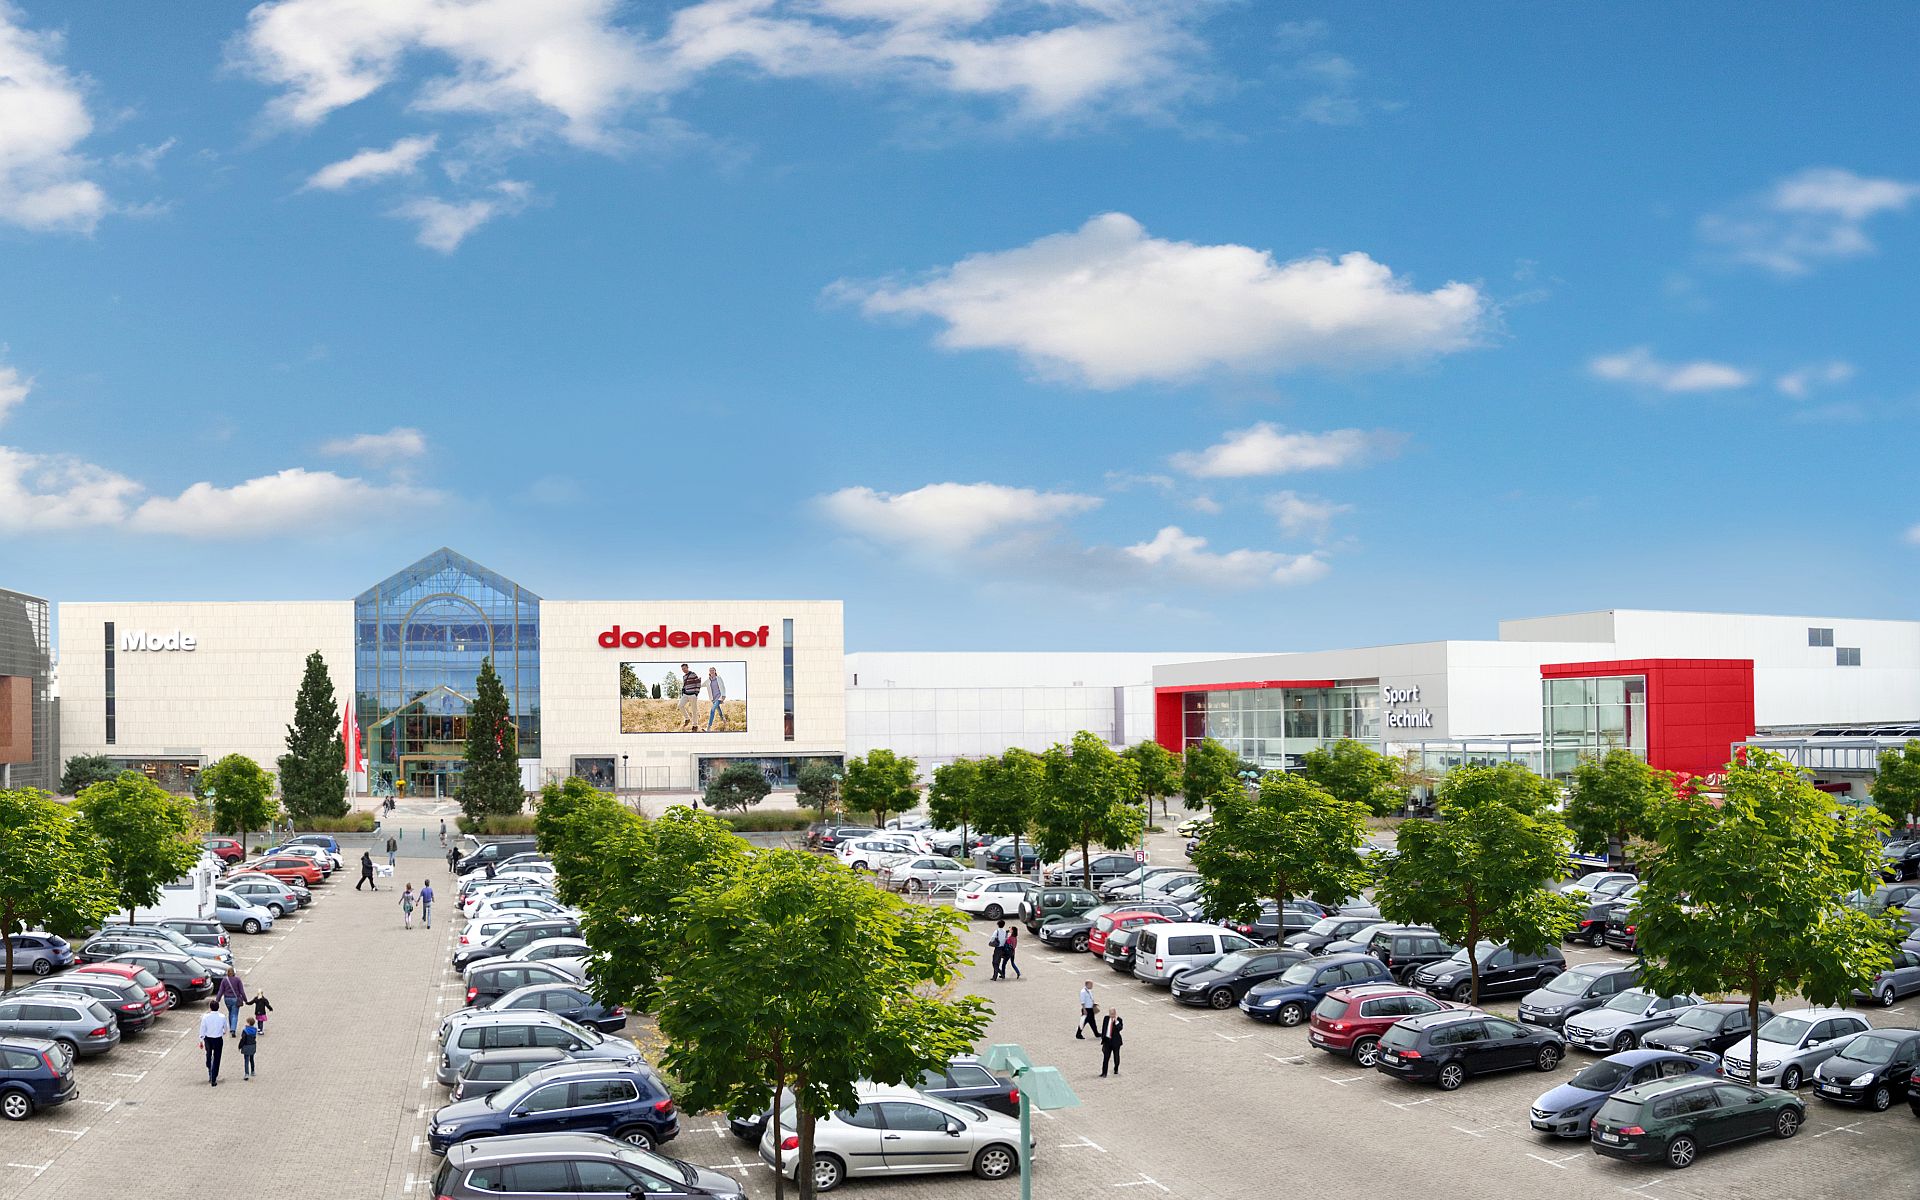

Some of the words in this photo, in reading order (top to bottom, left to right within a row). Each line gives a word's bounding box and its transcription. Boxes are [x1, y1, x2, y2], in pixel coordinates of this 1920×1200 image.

[121, 629, 197, 652] Mode
[598, 624, 770, 648] dodenhof
[1383, 684, 1420, 708] Sport
[1383, 708, 1432, 728] Technik
